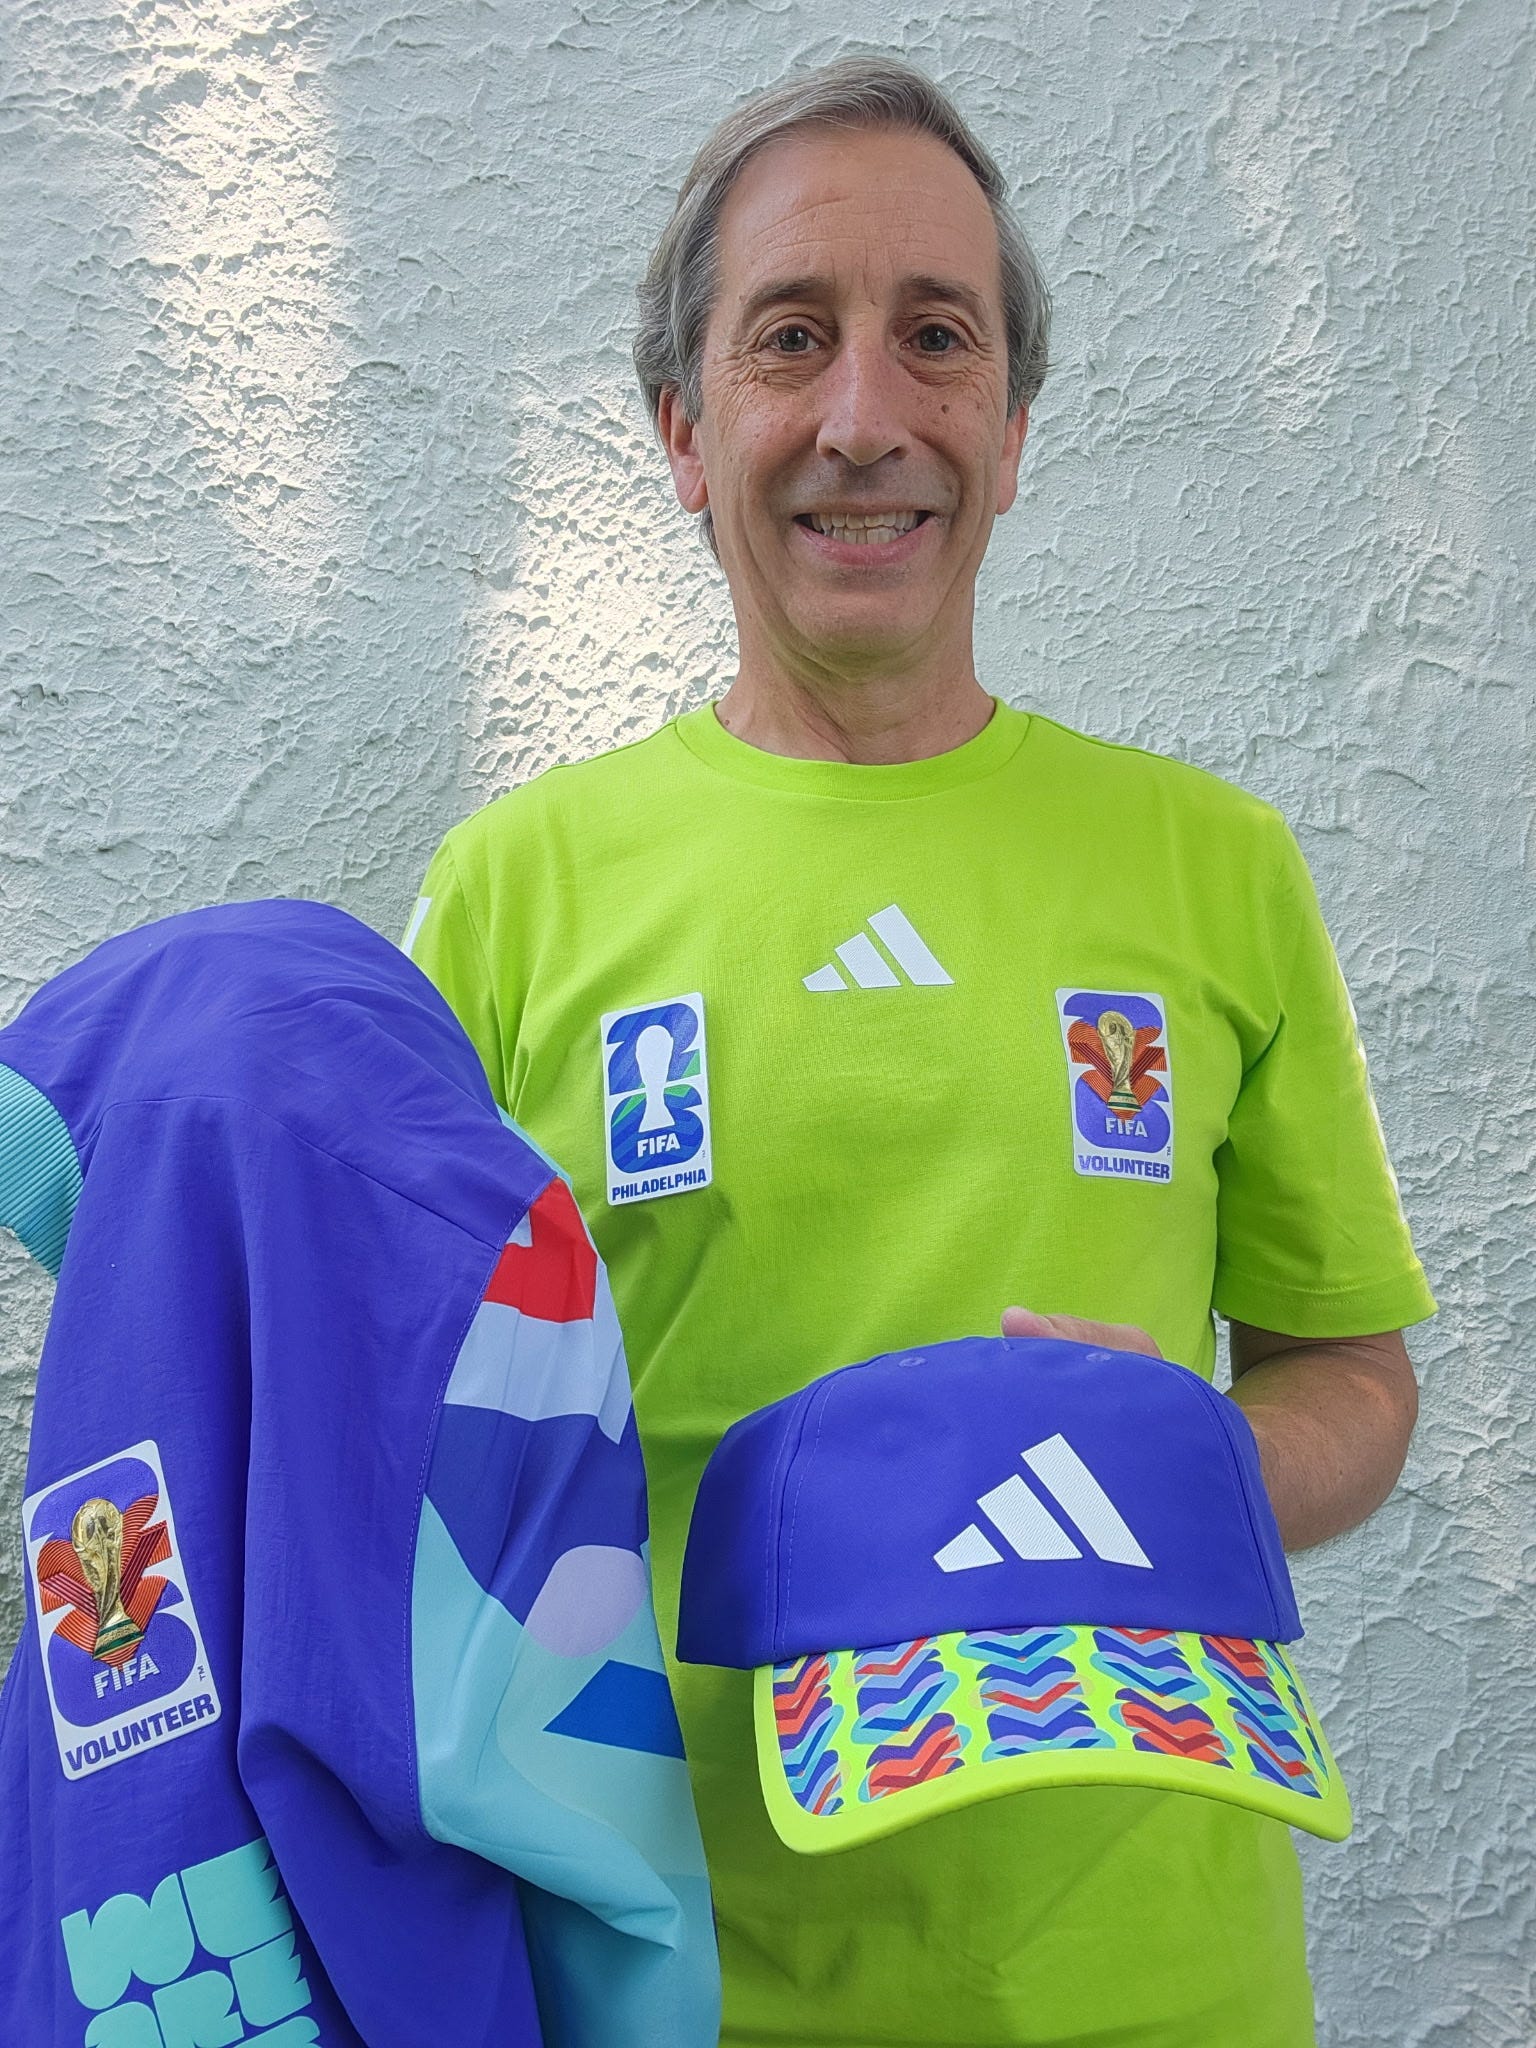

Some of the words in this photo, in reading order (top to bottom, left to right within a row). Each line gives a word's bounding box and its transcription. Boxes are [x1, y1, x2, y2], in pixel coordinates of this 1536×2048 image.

[1105, 1117, 1149, 1138] FIFA
[637, 1132, 681, 1159] FIFA
[1077, 1154, 1170, 1179] VOLUNTEER
[611, 1168, 707, 1201] PHILADELPHIA
[93, 1653, 160, 1699] FIFA
[197, 1665, 206, 1682] TM
[64, 1693, 216, 1772] VOLUNTEER
